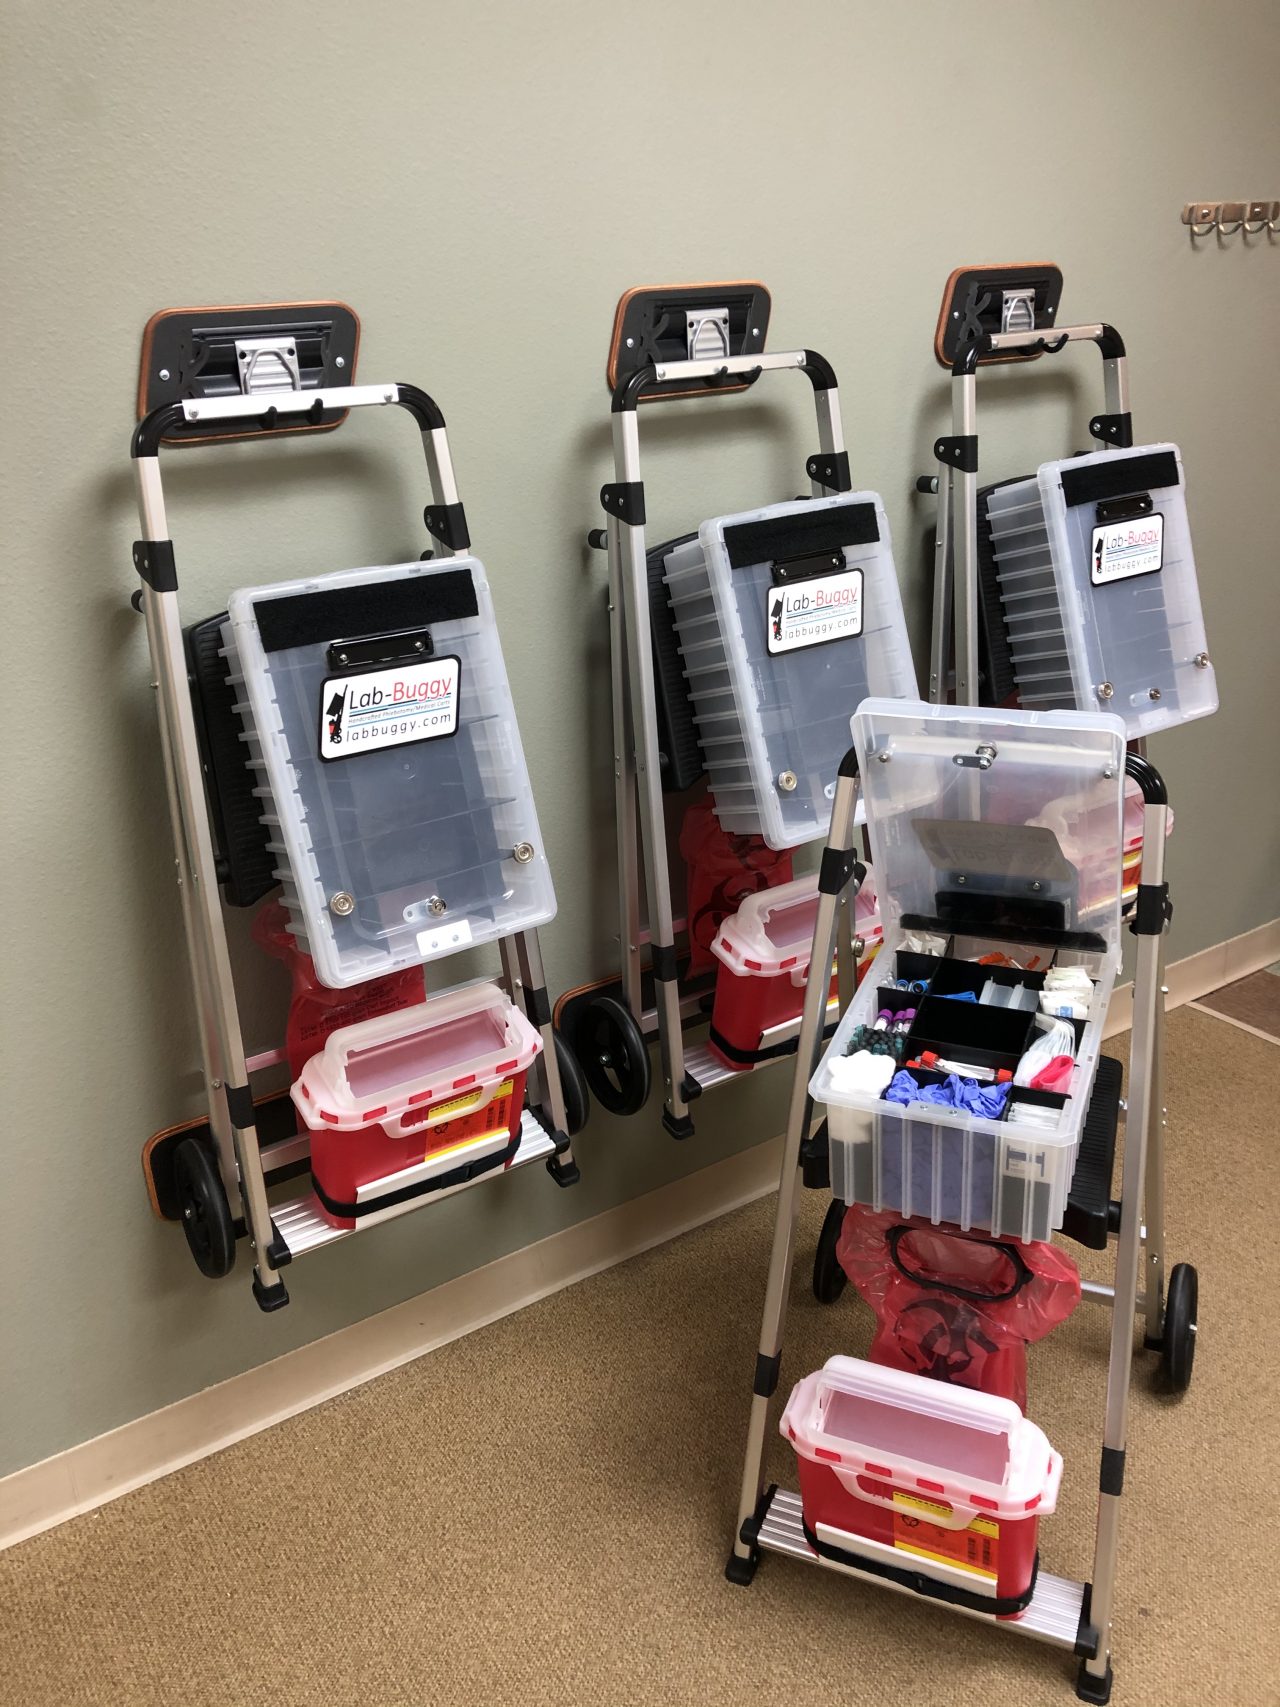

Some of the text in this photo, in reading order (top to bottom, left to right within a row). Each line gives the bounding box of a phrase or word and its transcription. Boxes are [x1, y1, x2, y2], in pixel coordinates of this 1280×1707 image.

[1106, 528, 1159, 550] Lab-Buggy
[786, 587, 858, 613] Lab-Buggy
[784, 617, 858, 640] labbuggy.com
[349, 677, 452, 710] Lab-Buggy
[346, 713, 451, 742] labbuggy.com
